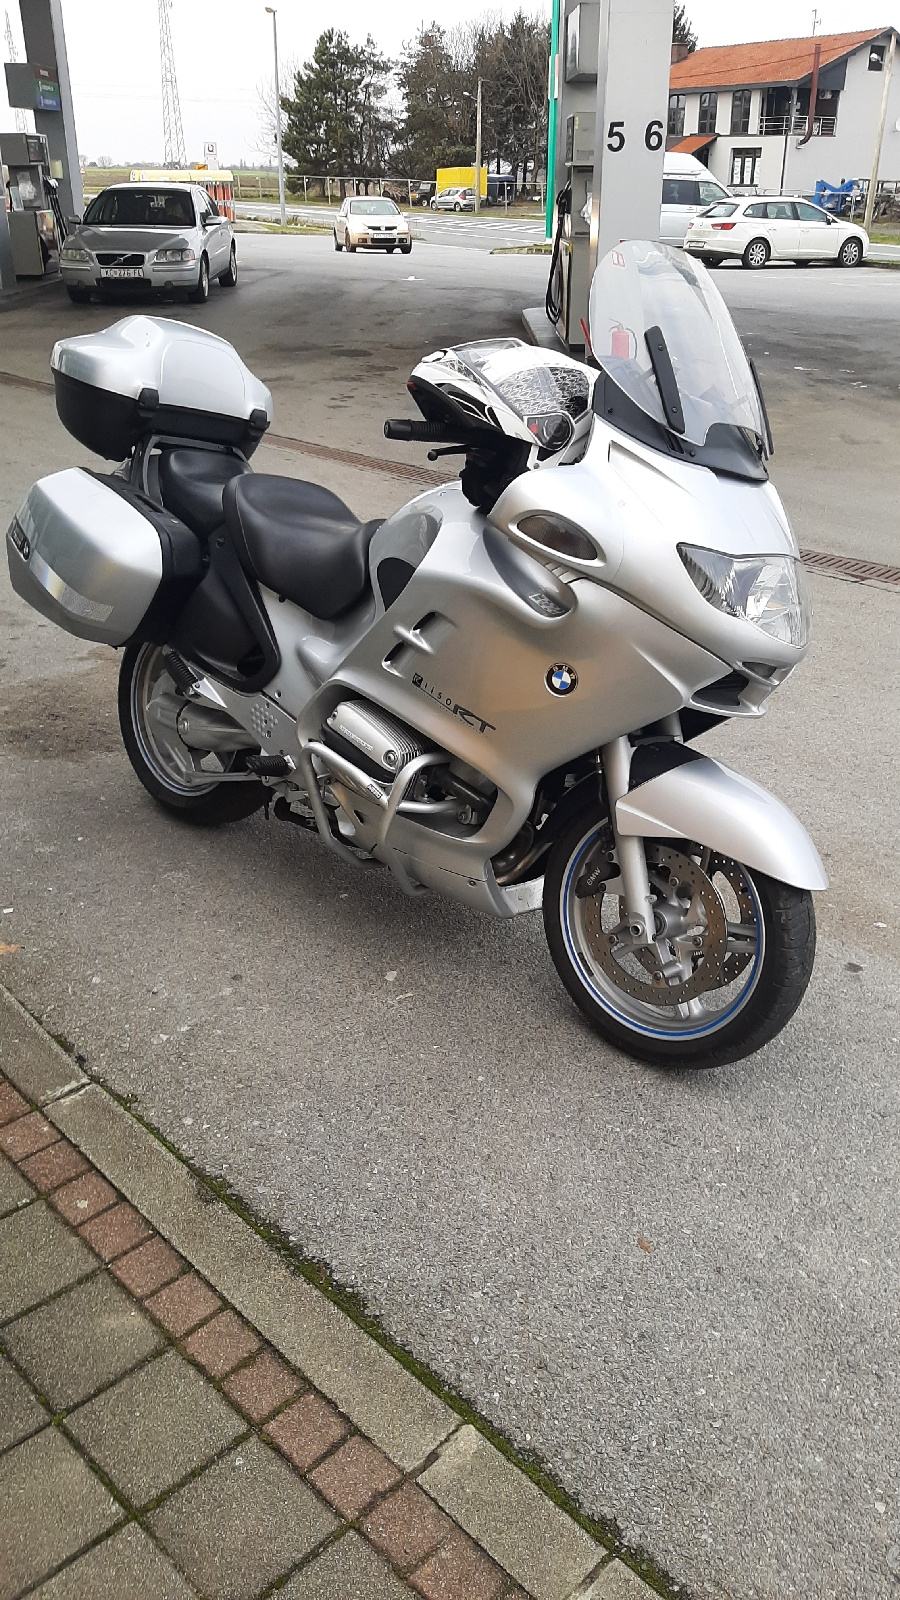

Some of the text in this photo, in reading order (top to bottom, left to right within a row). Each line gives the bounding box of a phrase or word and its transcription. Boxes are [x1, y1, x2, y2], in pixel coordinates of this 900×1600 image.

[607, 120, 663, 152] 5 6
[552, 664, 577, 680] BMW
[586, 866, 601, 886] BMW
